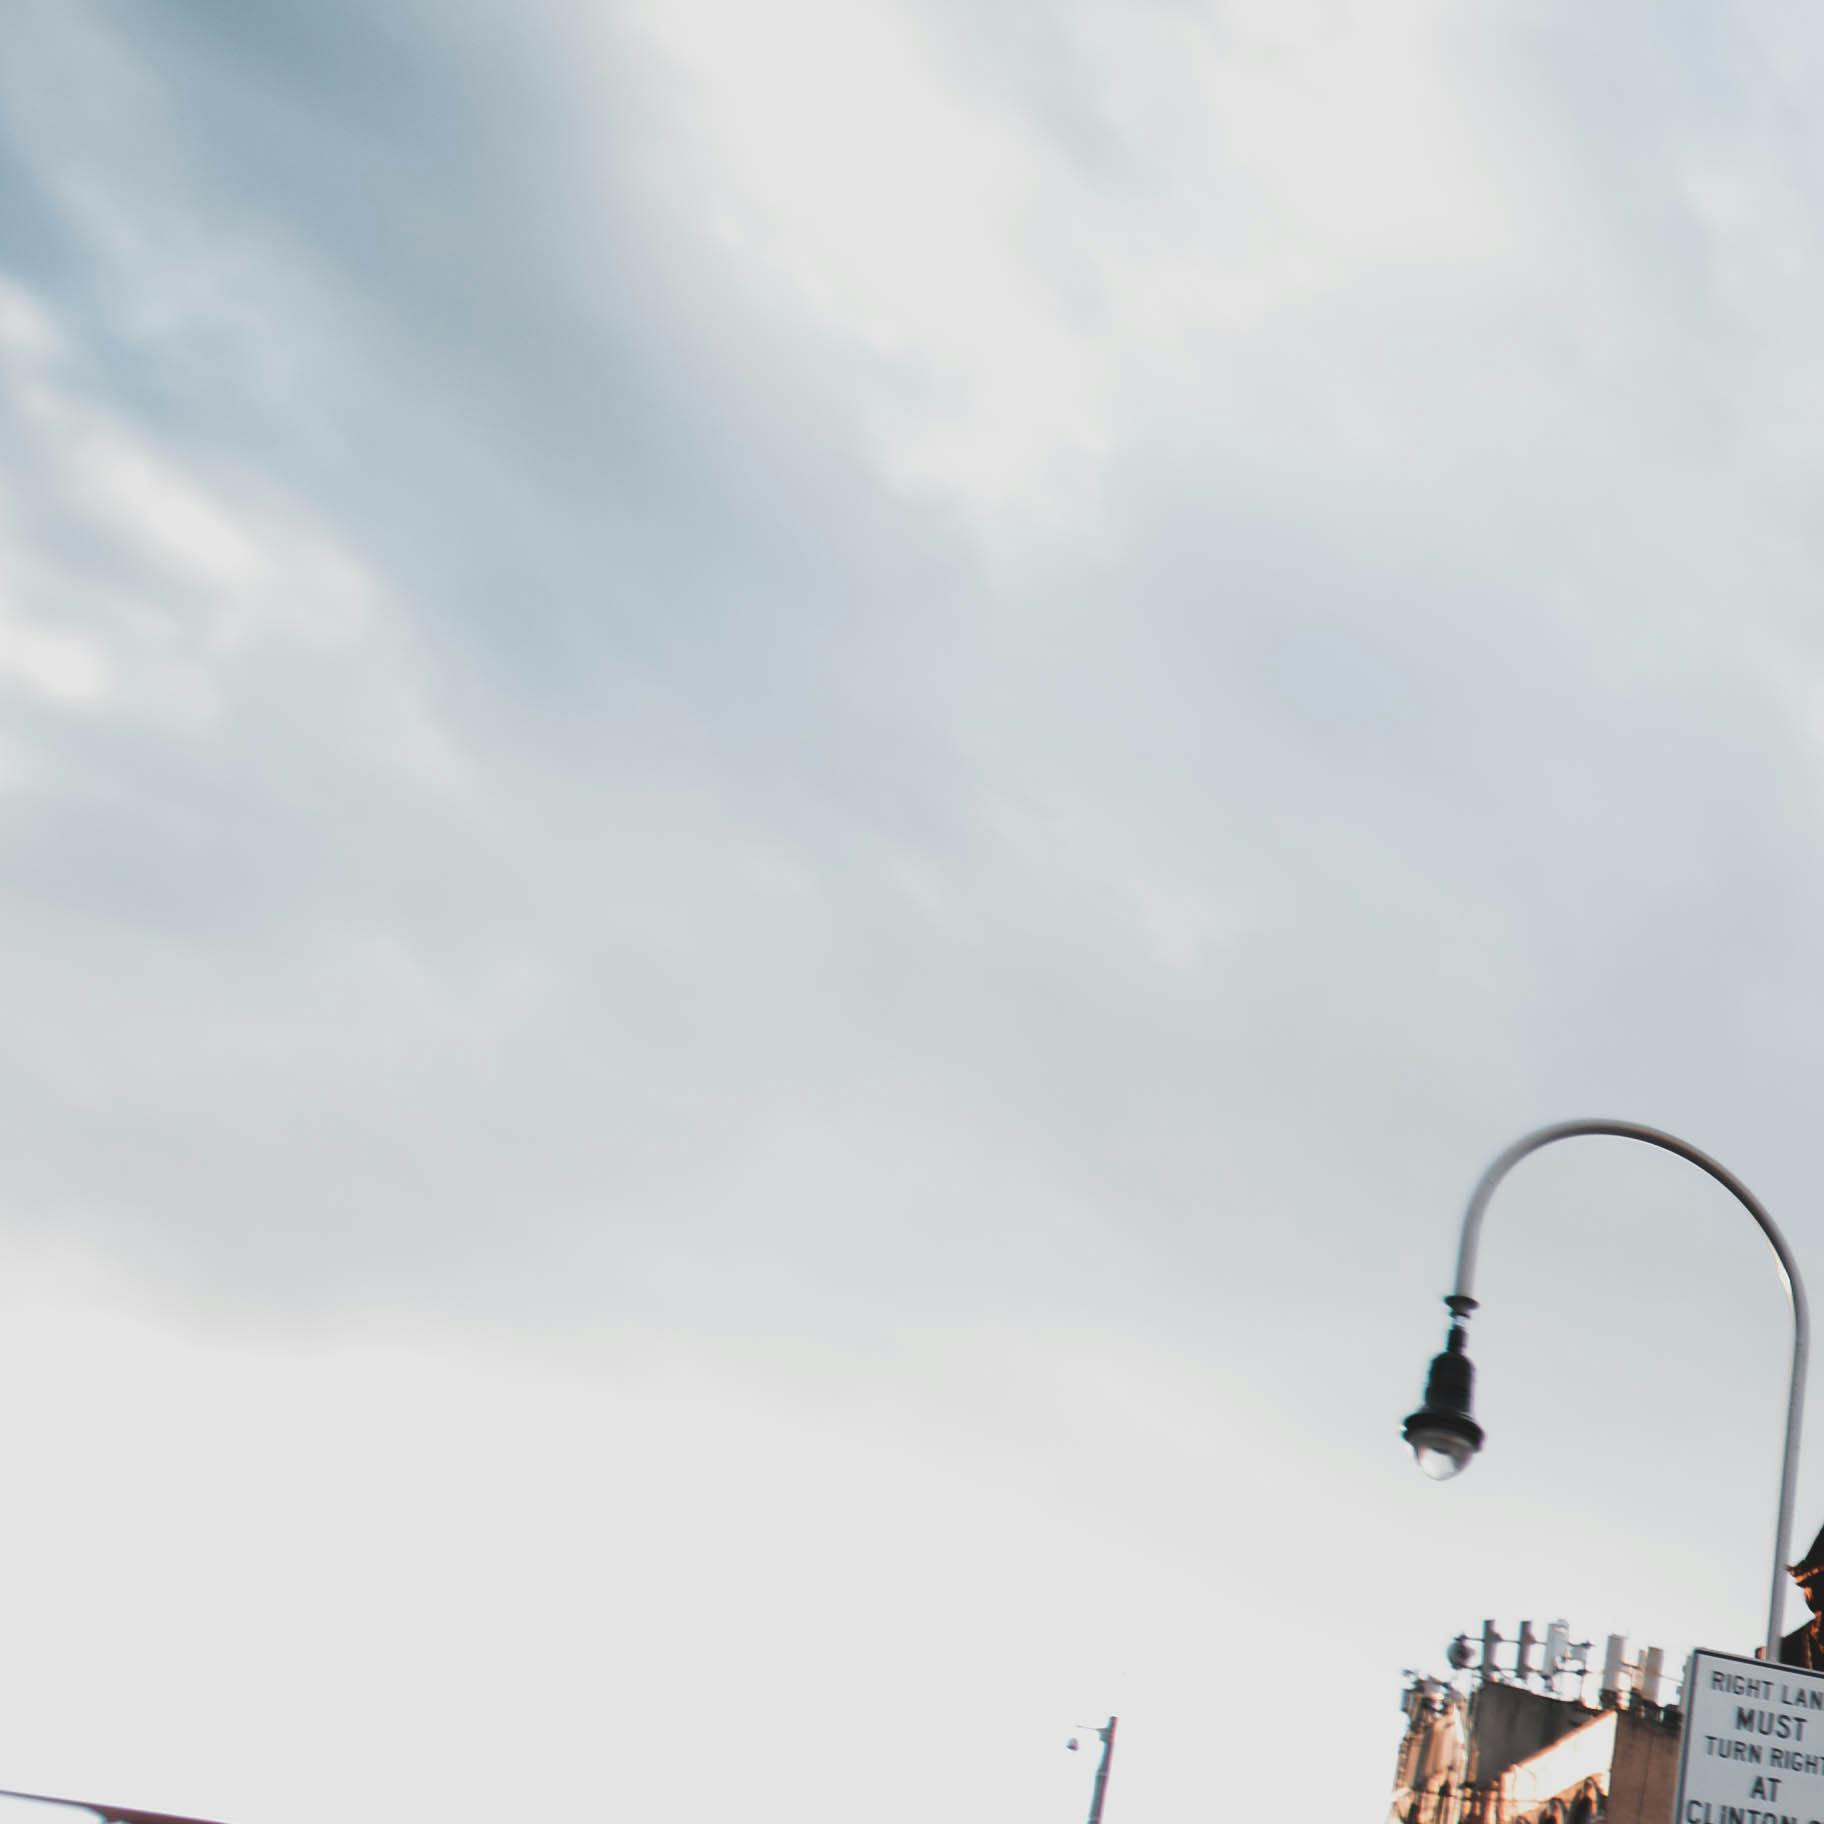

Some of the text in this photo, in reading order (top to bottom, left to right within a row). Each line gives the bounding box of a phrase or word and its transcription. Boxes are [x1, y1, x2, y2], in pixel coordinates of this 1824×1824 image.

[1711, 1670, 1774, 1700] RIGHT
[1734, 1706, 1807, 1742] MUST
[1705, 1735, 1762, 1765] TURN
[1750, 1776, 1782, 1803] AT
